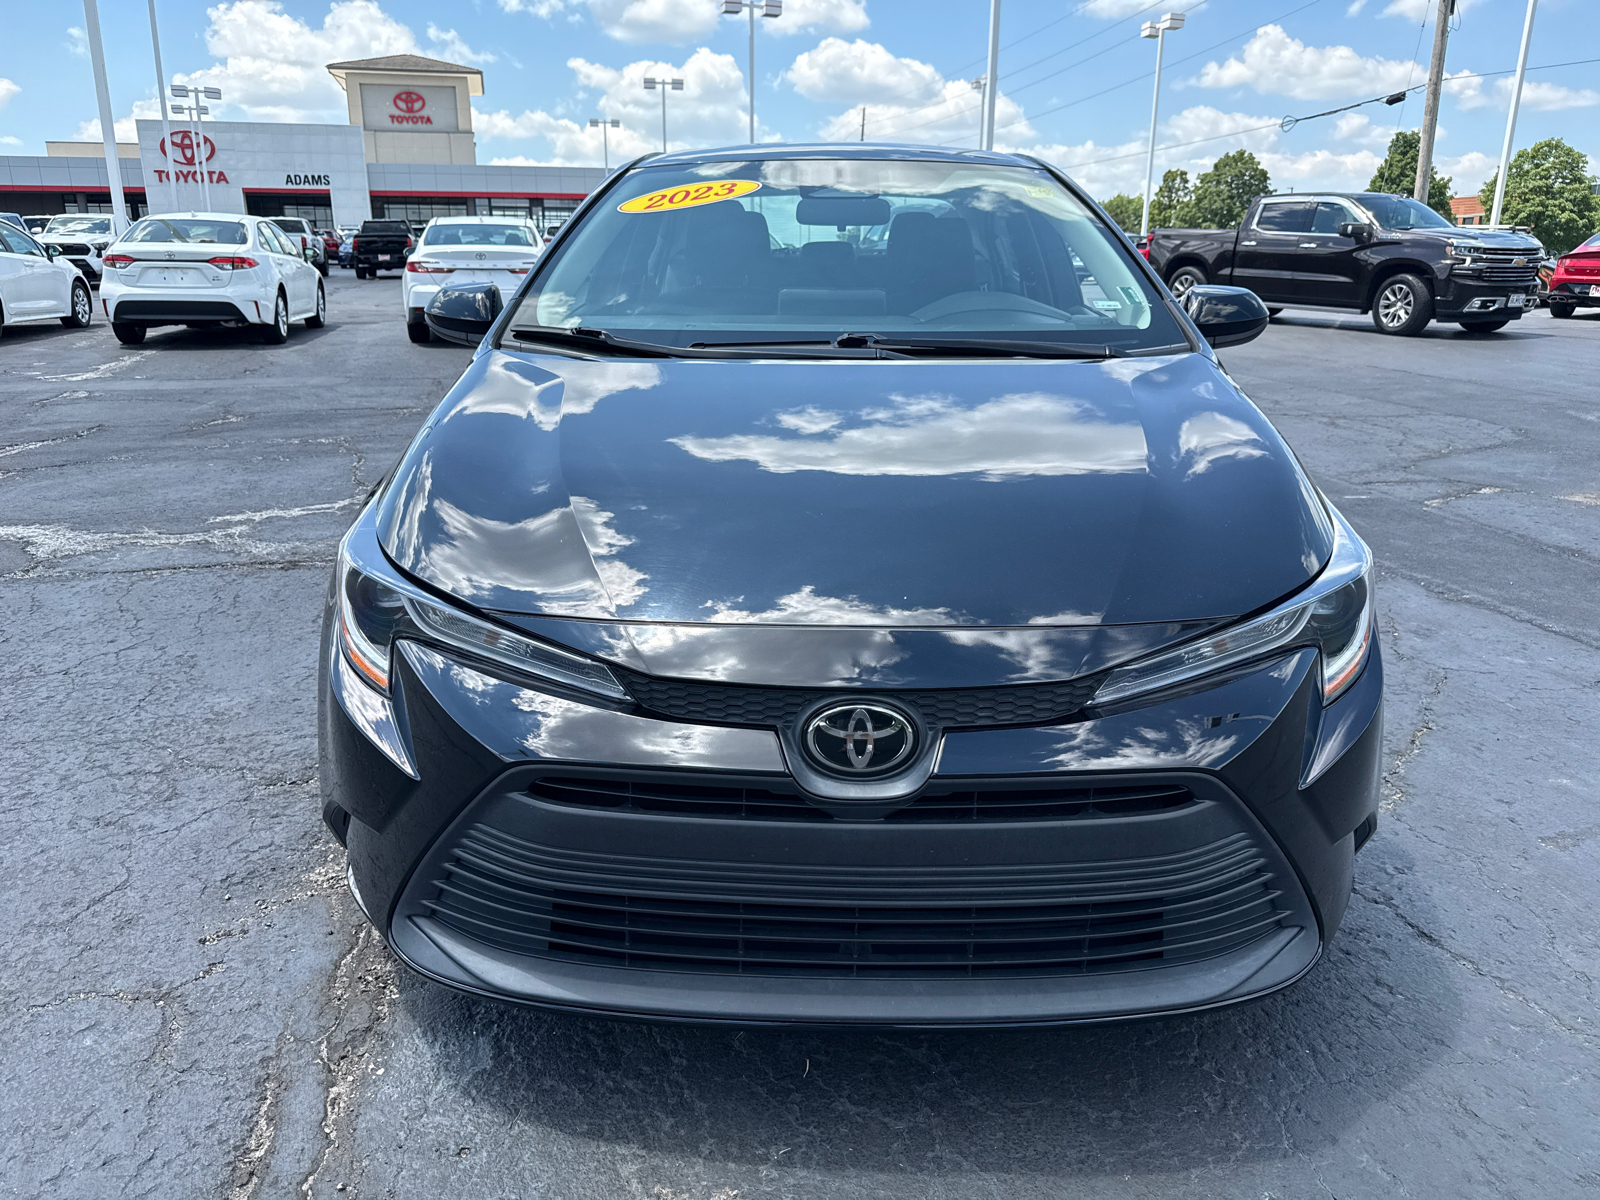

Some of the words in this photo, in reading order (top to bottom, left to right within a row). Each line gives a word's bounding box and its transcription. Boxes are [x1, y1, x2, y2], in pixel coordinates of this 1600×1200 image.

[389, 114, 433, 125] TOYOTA
[153, 169, 230, 184] TOYOTA
[285, 174, 331, 186] ADAMS
[643, 182, 738, 210] 2023
